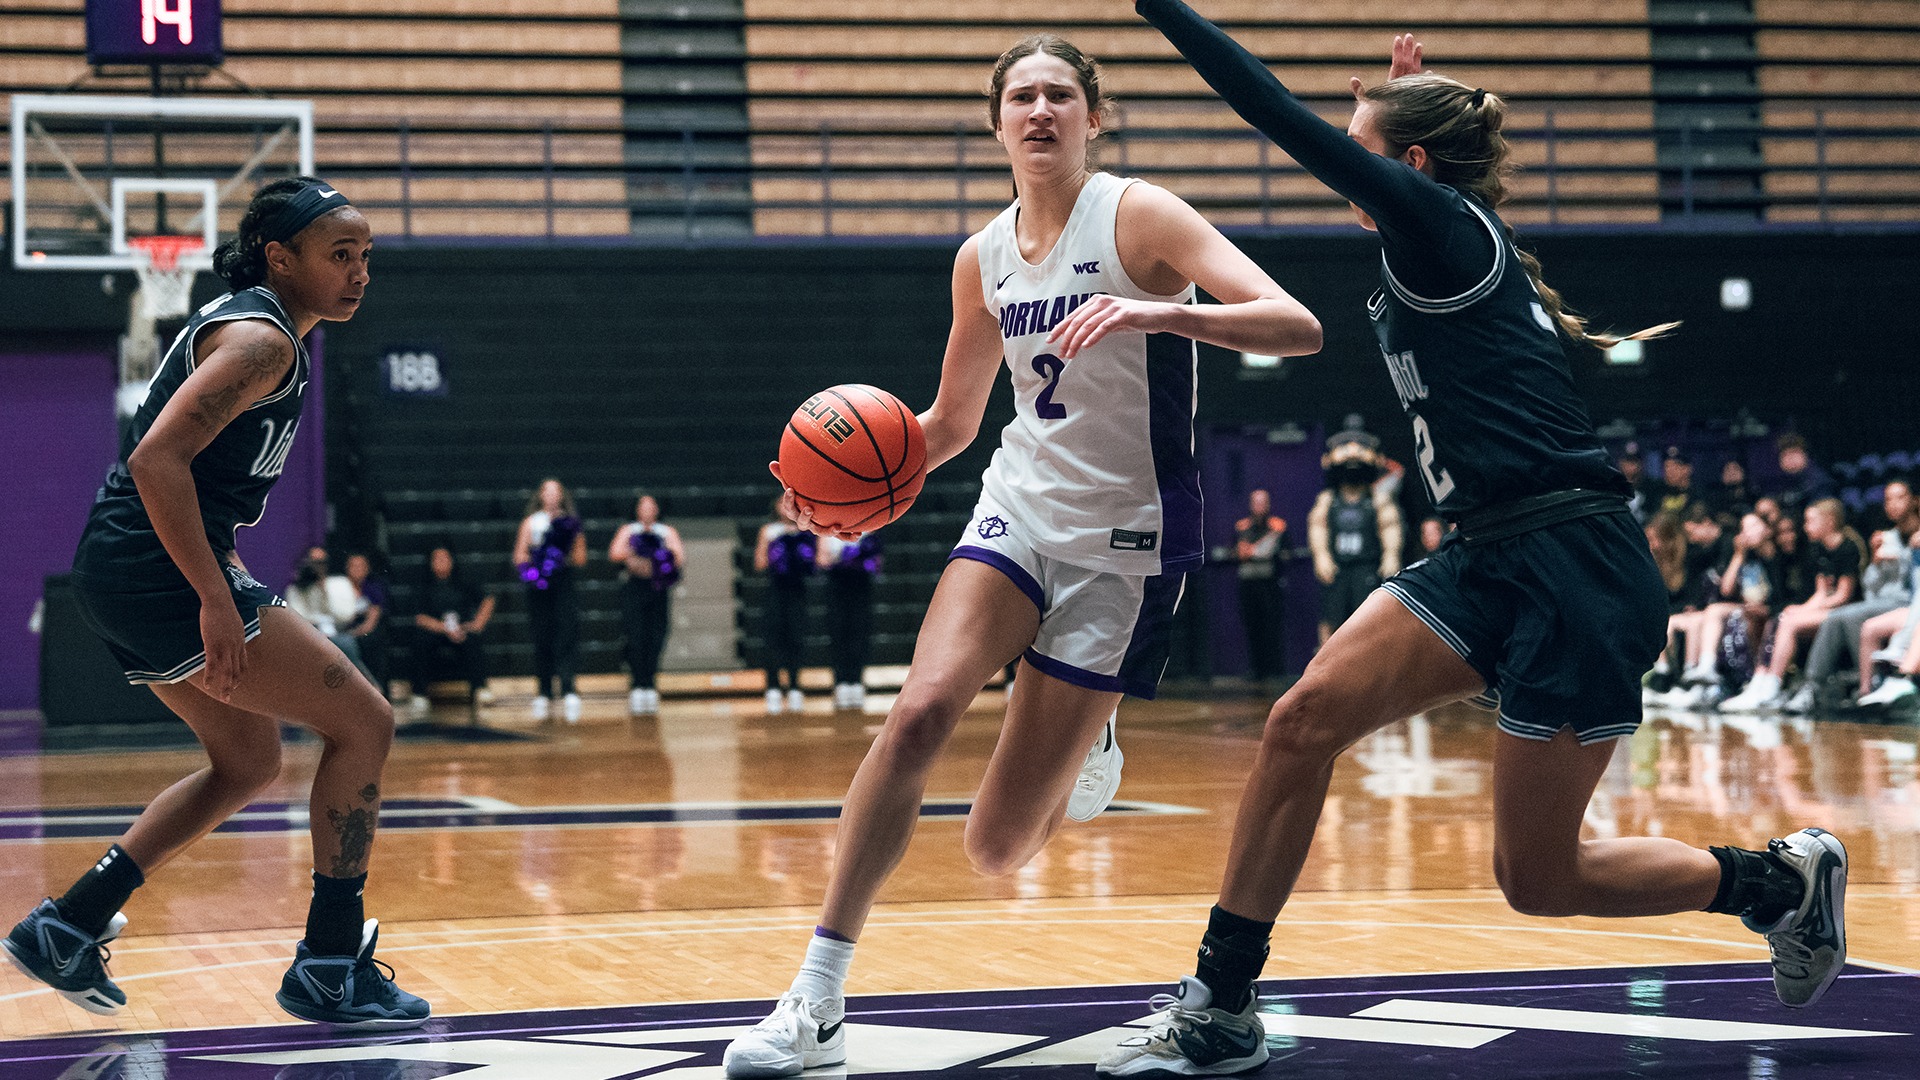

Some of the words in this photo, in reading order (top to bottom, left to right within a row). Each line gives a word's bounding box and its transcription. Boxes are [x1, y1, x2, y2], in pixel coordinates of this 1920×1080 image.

[141, 0, 193, 46] 14
[1072, 260, 1101, 275] WCC
[999, 291, 1109, 339] PORTLA
[1031, 353, 1067, 420] 2
[800, 395, 856, 444] ELITE
